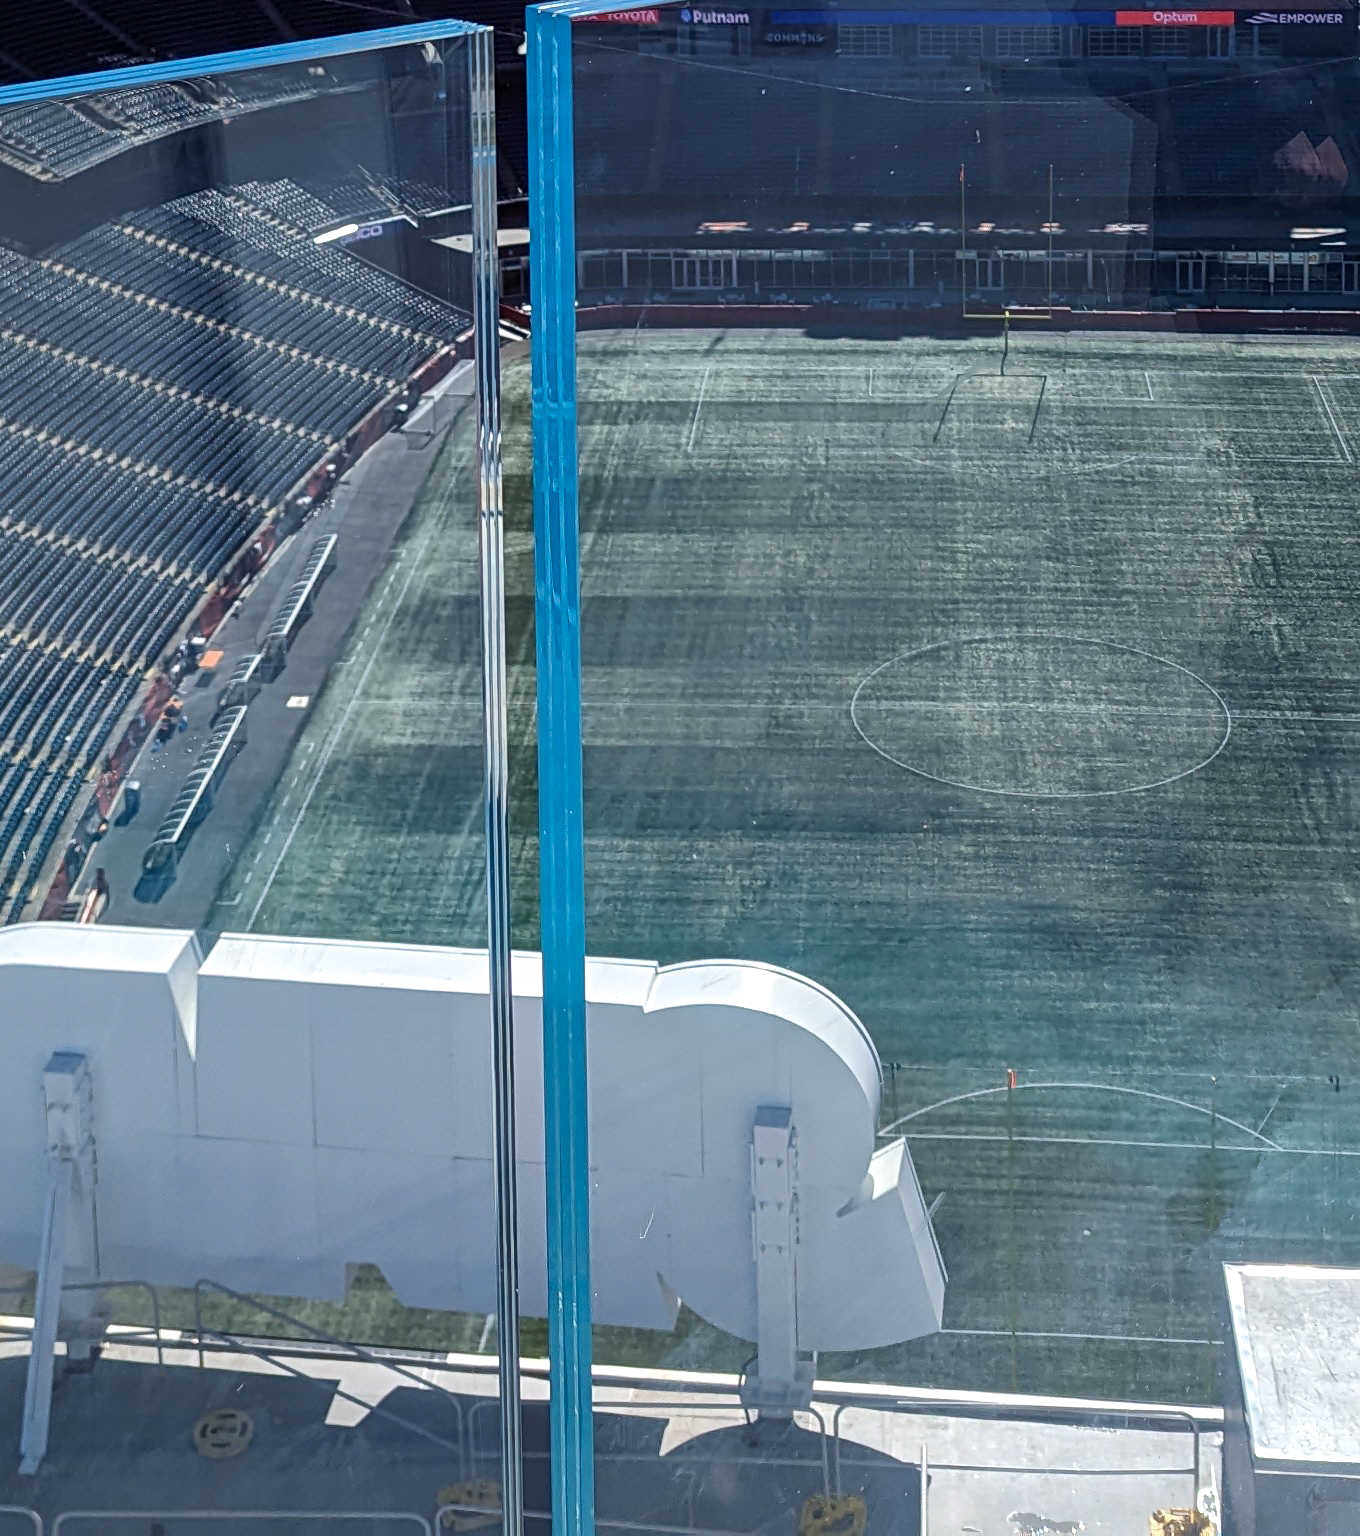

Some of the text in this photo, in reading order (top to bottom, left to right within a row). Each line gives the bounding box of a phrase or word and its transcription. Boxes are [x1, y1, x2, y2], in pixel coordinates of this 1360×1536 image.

[607, 10, 657, 23] TOYOTA
[693, 10, 750, 24] Putnam
[1152, 11, 1197, 24] Optum
[1280, 13, 1343, 24] EMPOWER
